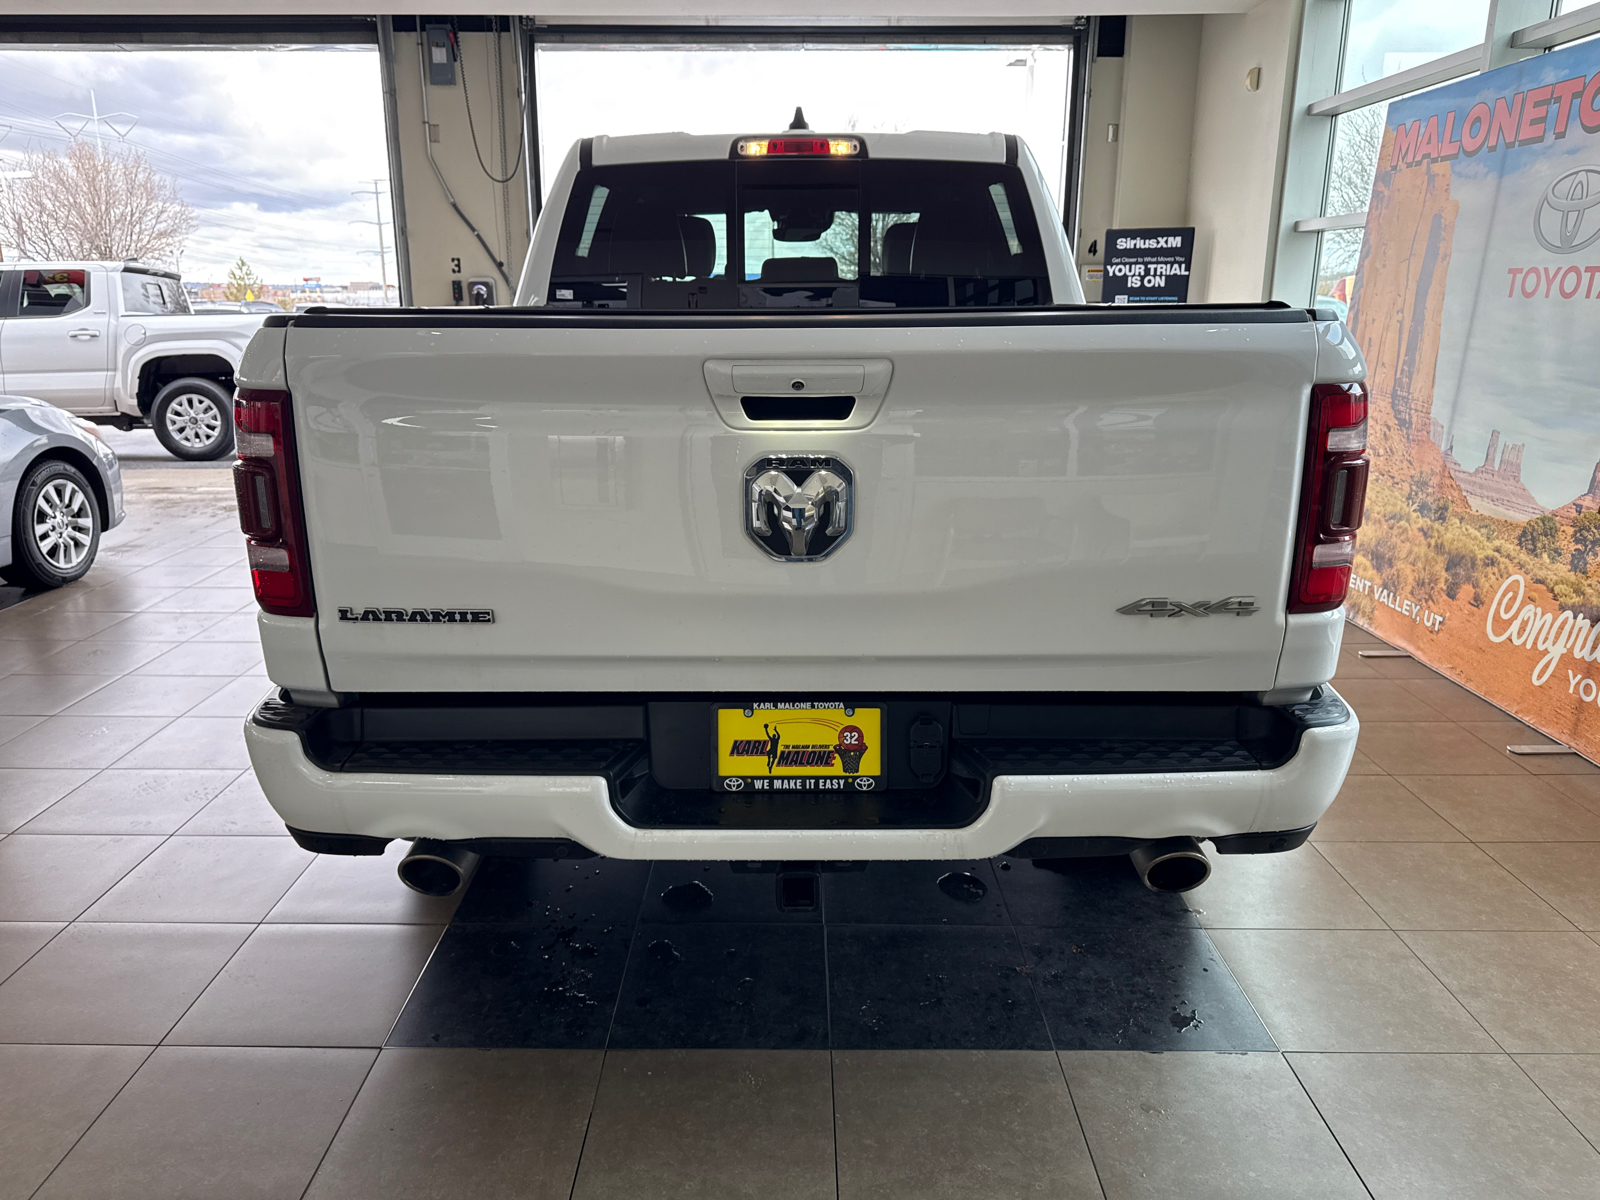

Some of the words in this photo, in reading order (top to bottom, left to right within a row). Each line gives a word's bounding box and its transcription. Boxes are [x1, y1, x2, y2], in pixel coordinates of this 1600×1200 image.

[1088, 240, 1098, 256] 4
[1116, 236, 1182, 250] SiriusXM
[451, 257, 461, 274] 3
[1106, 264, 1145, 277] YOUR
[1148, 263, 1189, 275] TRIAL
[1127, 276, 1141, 288] IS
[1143, 276, 1165, 287] ON
[1507, 265, 1600, 299] TOYOT
[765, 458, 833, 468] RAM
[338, 606, 495, 624] LARAMIE
[1374, 584, 1420, 624] VALLEY,
[1423, 609, 1443, 632] UT
[1568, 669, 1600, 708] YO
[777, 702, 812, 710] MALONE
[843, 732, 858, 745] 32
[729, 739, 769, 756] KARL
[776, 749, 836, 767] MALONE
[754, 779, 769, 789] WE
[773, 779, 802, 789] MAKE
[806, 779, 815, 789] IT
[819, 779, 844, 789] EASY
